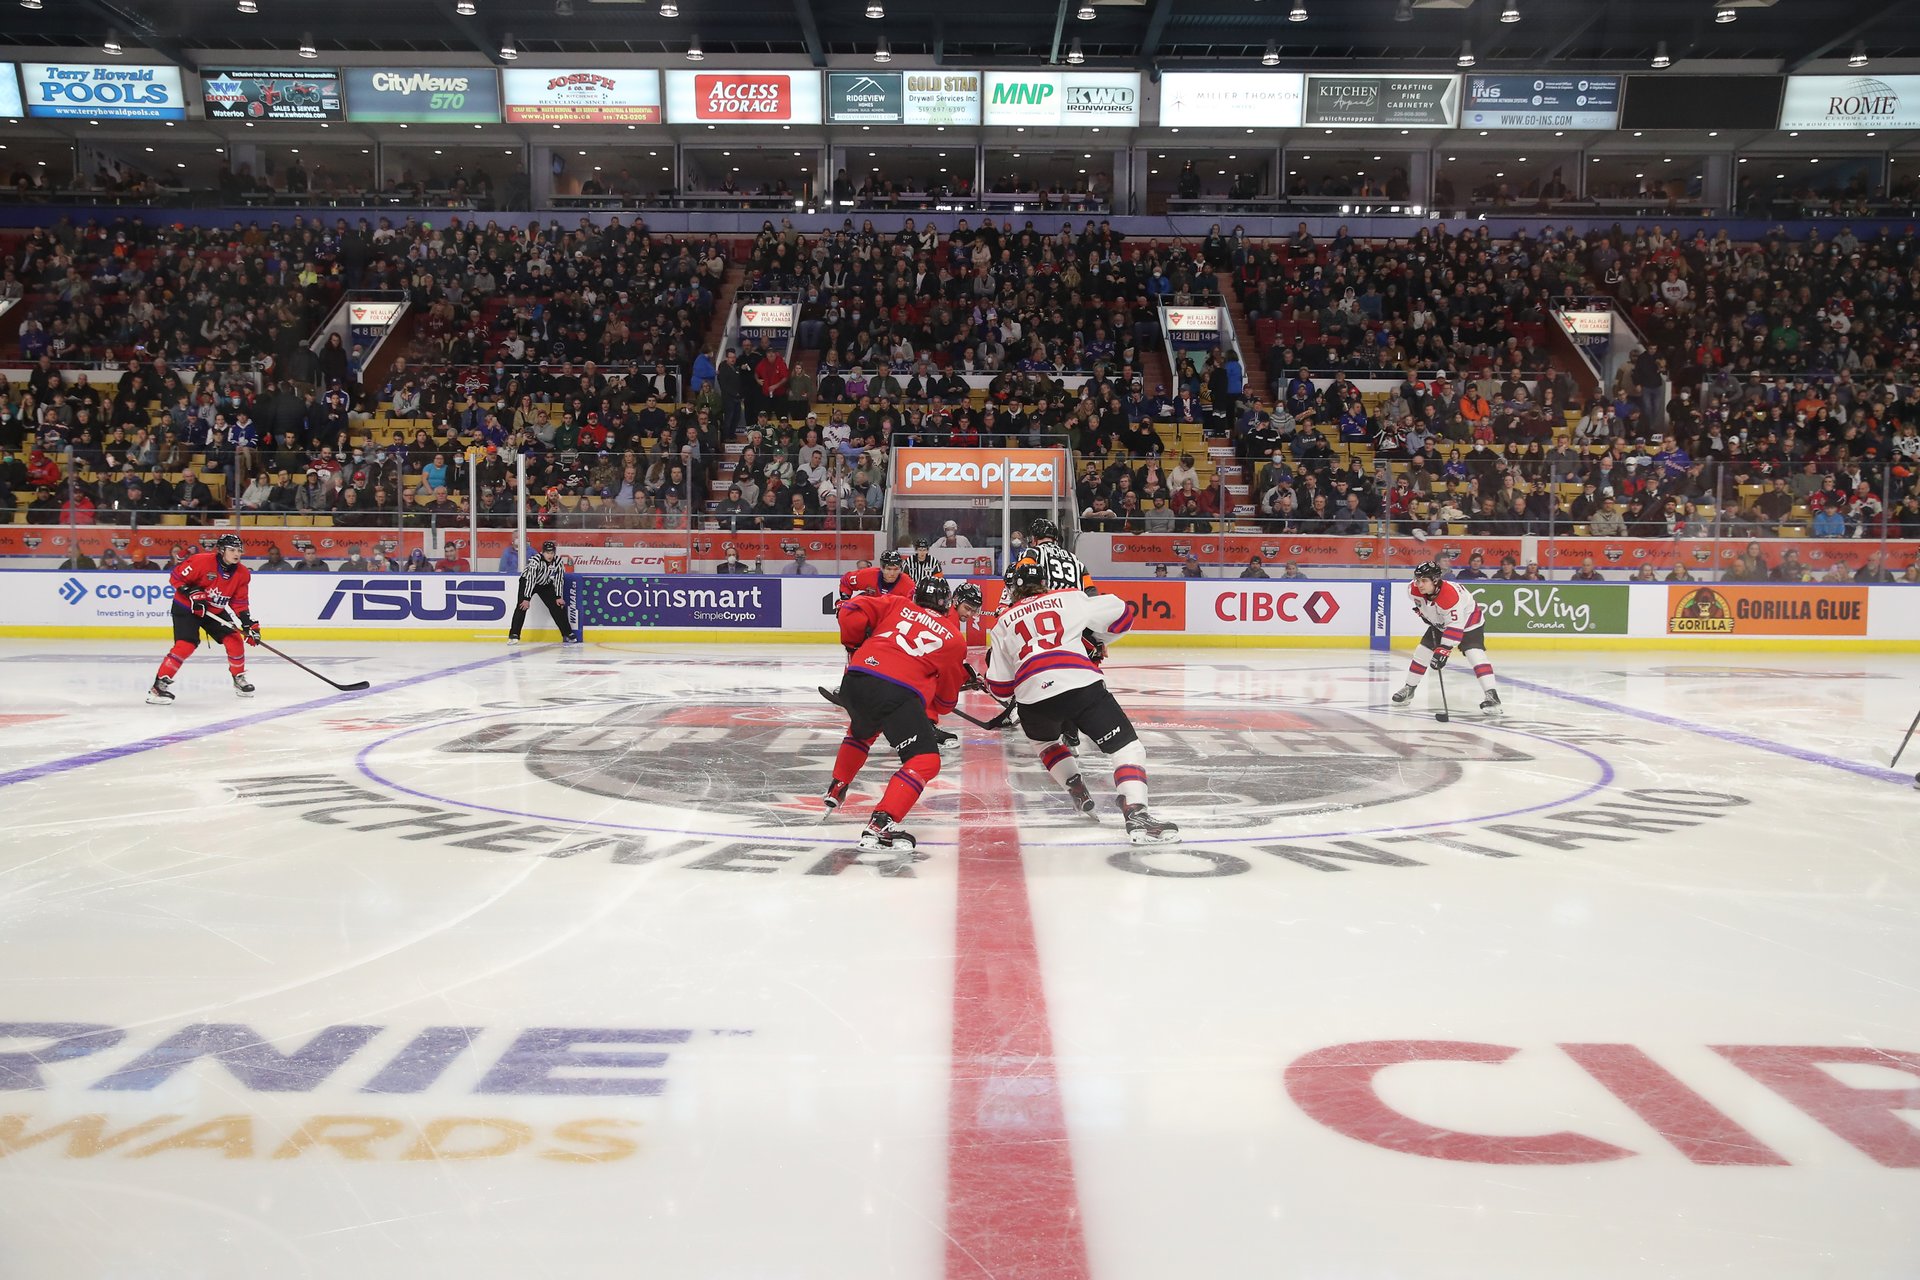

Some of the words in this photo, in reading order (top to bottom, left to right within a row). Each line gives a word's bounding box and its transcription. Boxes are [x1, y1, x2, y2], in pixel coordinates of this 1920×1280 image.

[46, 67, 90, 82] Terry
[93, 69, 153, 81] Howald
[372, 73, 468, 95] CityNews
[547, 73, 616, 91] JOSEPH
[908, 76, 942, 92] GOLD
[944, 76, 978, 92] STAR
[40, 82, 168, 104] POOLS
[708, 81, 779, 100] ACCESS
[992, 83, 1053, 105] MNP
[1067, 87, 1134, 105] KWO
[1197, 92, 1238, 100] MILLER
[1245, 92, 1299, 100] THOMSON
[1320, 86, 1379, 97] KITCHEN
[1472, 87, 1501, 98] INS
[430, 93, 465, 109] 570
[708, 99, 779, 113] STORAGE
[909, 95, 934, 103] Drywall
[1387, 101, 1435, 109] CABINETRY
[1827, 96, 1896, 115] ROME
[55, 107, 160, 118] www.terryhowaldpools.ca
[212, 110, 244, 118] Waterloo
[1501, 115, 1573, 126] WWW.GO-INS.COM
[749, 329, 759, 337] 10
[777, 329, 788, 337] 12
[1172, 332, 1182, 340] 12
[1201, 332, 1211, 340] 14
[1590, 336, 1599, 344] 16
[905, 462, 980, 489] pizza
[154, 538, 188, 546] Kubota
[244, 538, 275, 546] Kubota
[824, 542, 858, 550] Kuota
[1305, 546, 1338, 554] Kubota
[1398, 547, 1431, 555] Kubota
[1487, 547, 1520, 556] Kubota
[1825, 551, 1858, 559] Kubota
[573, 555, 588, 565] Tim
[588, 556, 621, 566] Hortons
[951, 557, 977, 565] CC
[181, 565, 193, 577] 5
[1050, 558, 1076, 583] 33
[95, 584, 175, 606] co-ope
[317, 580, 507, 621] ASUS
[607, 584, 762, 608] coinsmart
[97, 610, 135, 618] Investing
[1003, 597, 1063, 628] LUDWINSKI
[1215, 592, 1299, 622] CIBC
[1513, 587, 1591, 632] RVing
[1736, 598, 1811, 620] GORILLA
[1816, 598, 1861, 621] GLUE
[693, 611, 756, 621] SimpleCrypto
[1450, 609, 1458, 622] 5
[900, 607, 954, 640] SEMINOFF
[1526, 620, 1565, 629] Canada
[1678, 620, 1727, 631] GORILLA
[1014, 610, 1065, 661] 19
[1107, 687, 1366, 705] OCKEY
[480, 725, 732, 752] TOP
[1096, 725, 1121, 745] CCM
[896, 735, 918, 752] CCM
[219, 773, 932, 878] KITCHENER
[1106, 787, 1751, 879] ONTARIO
